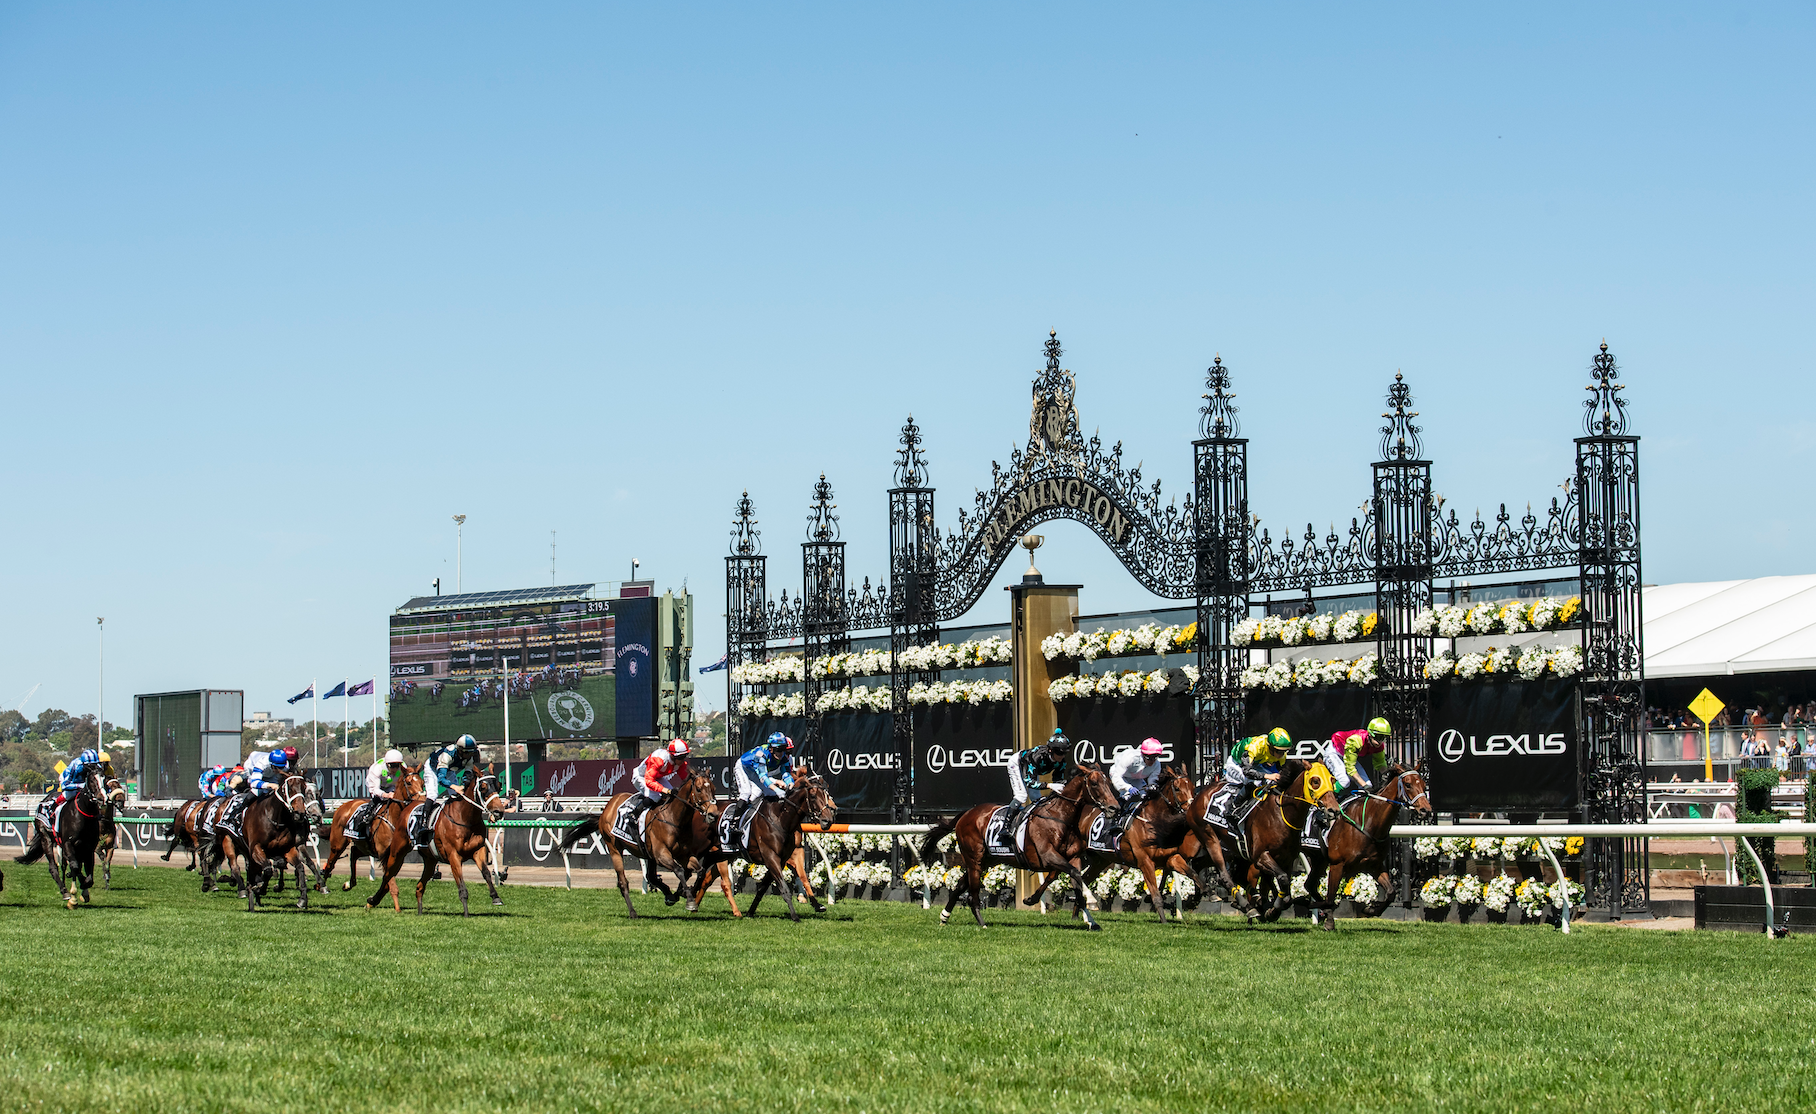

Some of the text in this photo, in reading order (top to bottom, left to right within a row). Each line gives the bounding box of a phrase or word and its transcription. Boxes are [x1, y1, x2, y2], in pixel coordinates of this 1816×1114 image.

[982, 478, 1129, 559] FLEMINGTON
[587, 601, 610, 612] 3:19.5
[616, 643, 650, 658] FLEMINGTON
[396, 665, 425, 675] LEXUS
[1469, 733, 1567, 756] LEXUS
[331, 769, 371, 798] FURPH
[522, 775, 533, 787] TAB
[598, 761, 626, 797] Penfolds
[719, 820, 730, 845] 3
[988, 820, 1004, 847] 12
[1091, 817, 1105, 841] 9
